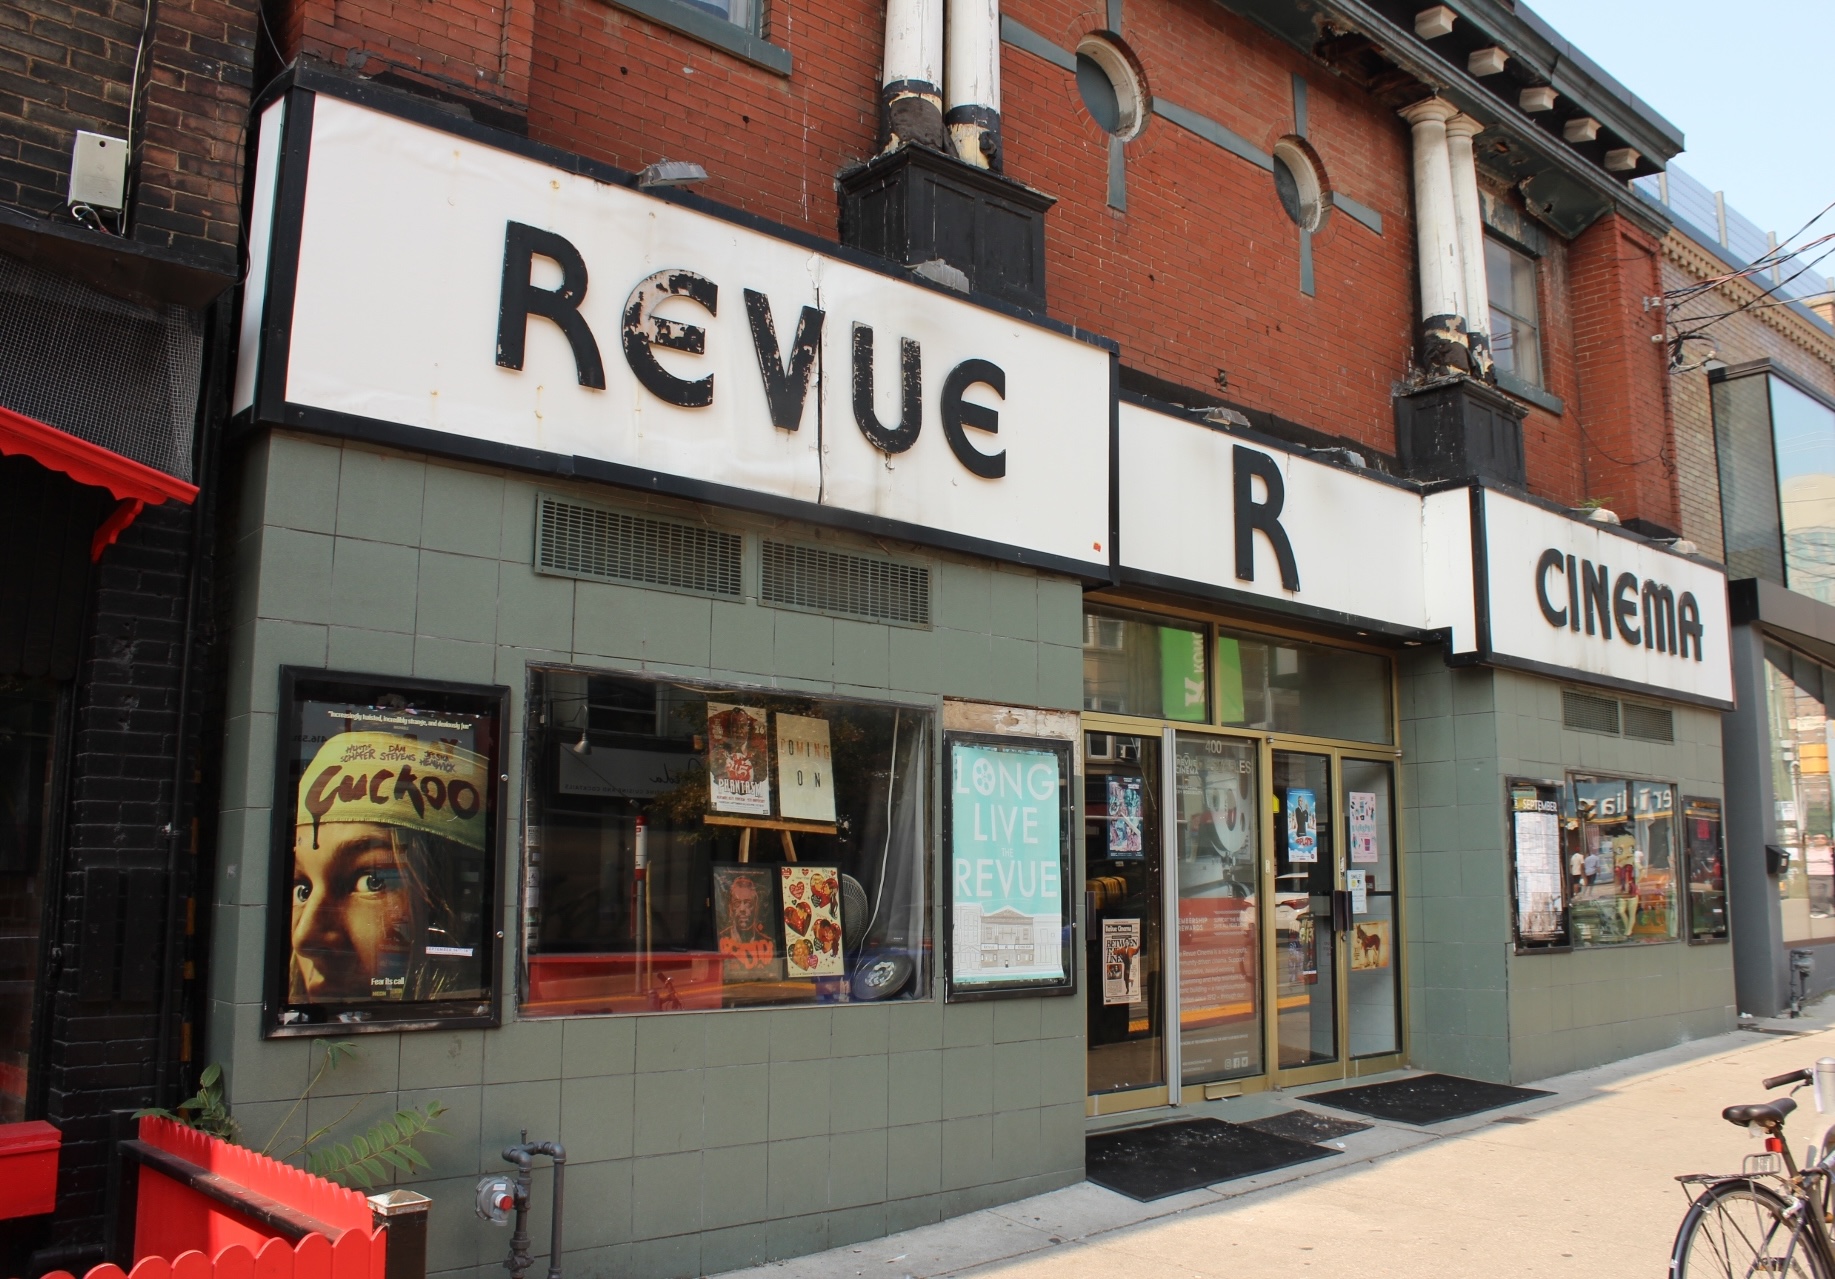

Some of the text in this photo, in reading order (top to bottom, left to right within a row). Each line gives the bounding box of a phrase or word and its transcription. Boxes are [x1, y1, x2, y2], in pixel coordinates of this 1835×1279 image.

[495, 219, 1006, 480] REVUE
[1232, 444, 1300, 592] R
[1536, 548, 1704, 662] CINEMA
[380, 751, 416, 761] STEVENS
[780, 738, 831, 761] COMING
[1205, 740, 1222, 754] 400
[718, 778, 764, 798] PHANTASM
[797, 769, 821, 788] ON
[956, 755, 1055, 801] LONG
[1522, 798, 1557, 812] SEPTEMBER
[974, 803, 1038, 844] LIVE
[1001, 848, 1014, 858] THE
[955, 858, 1058, 899] REVUE
[1106, 939, 1138, 948] BETWEN
[370, 976, 405, 986] Fear its call
